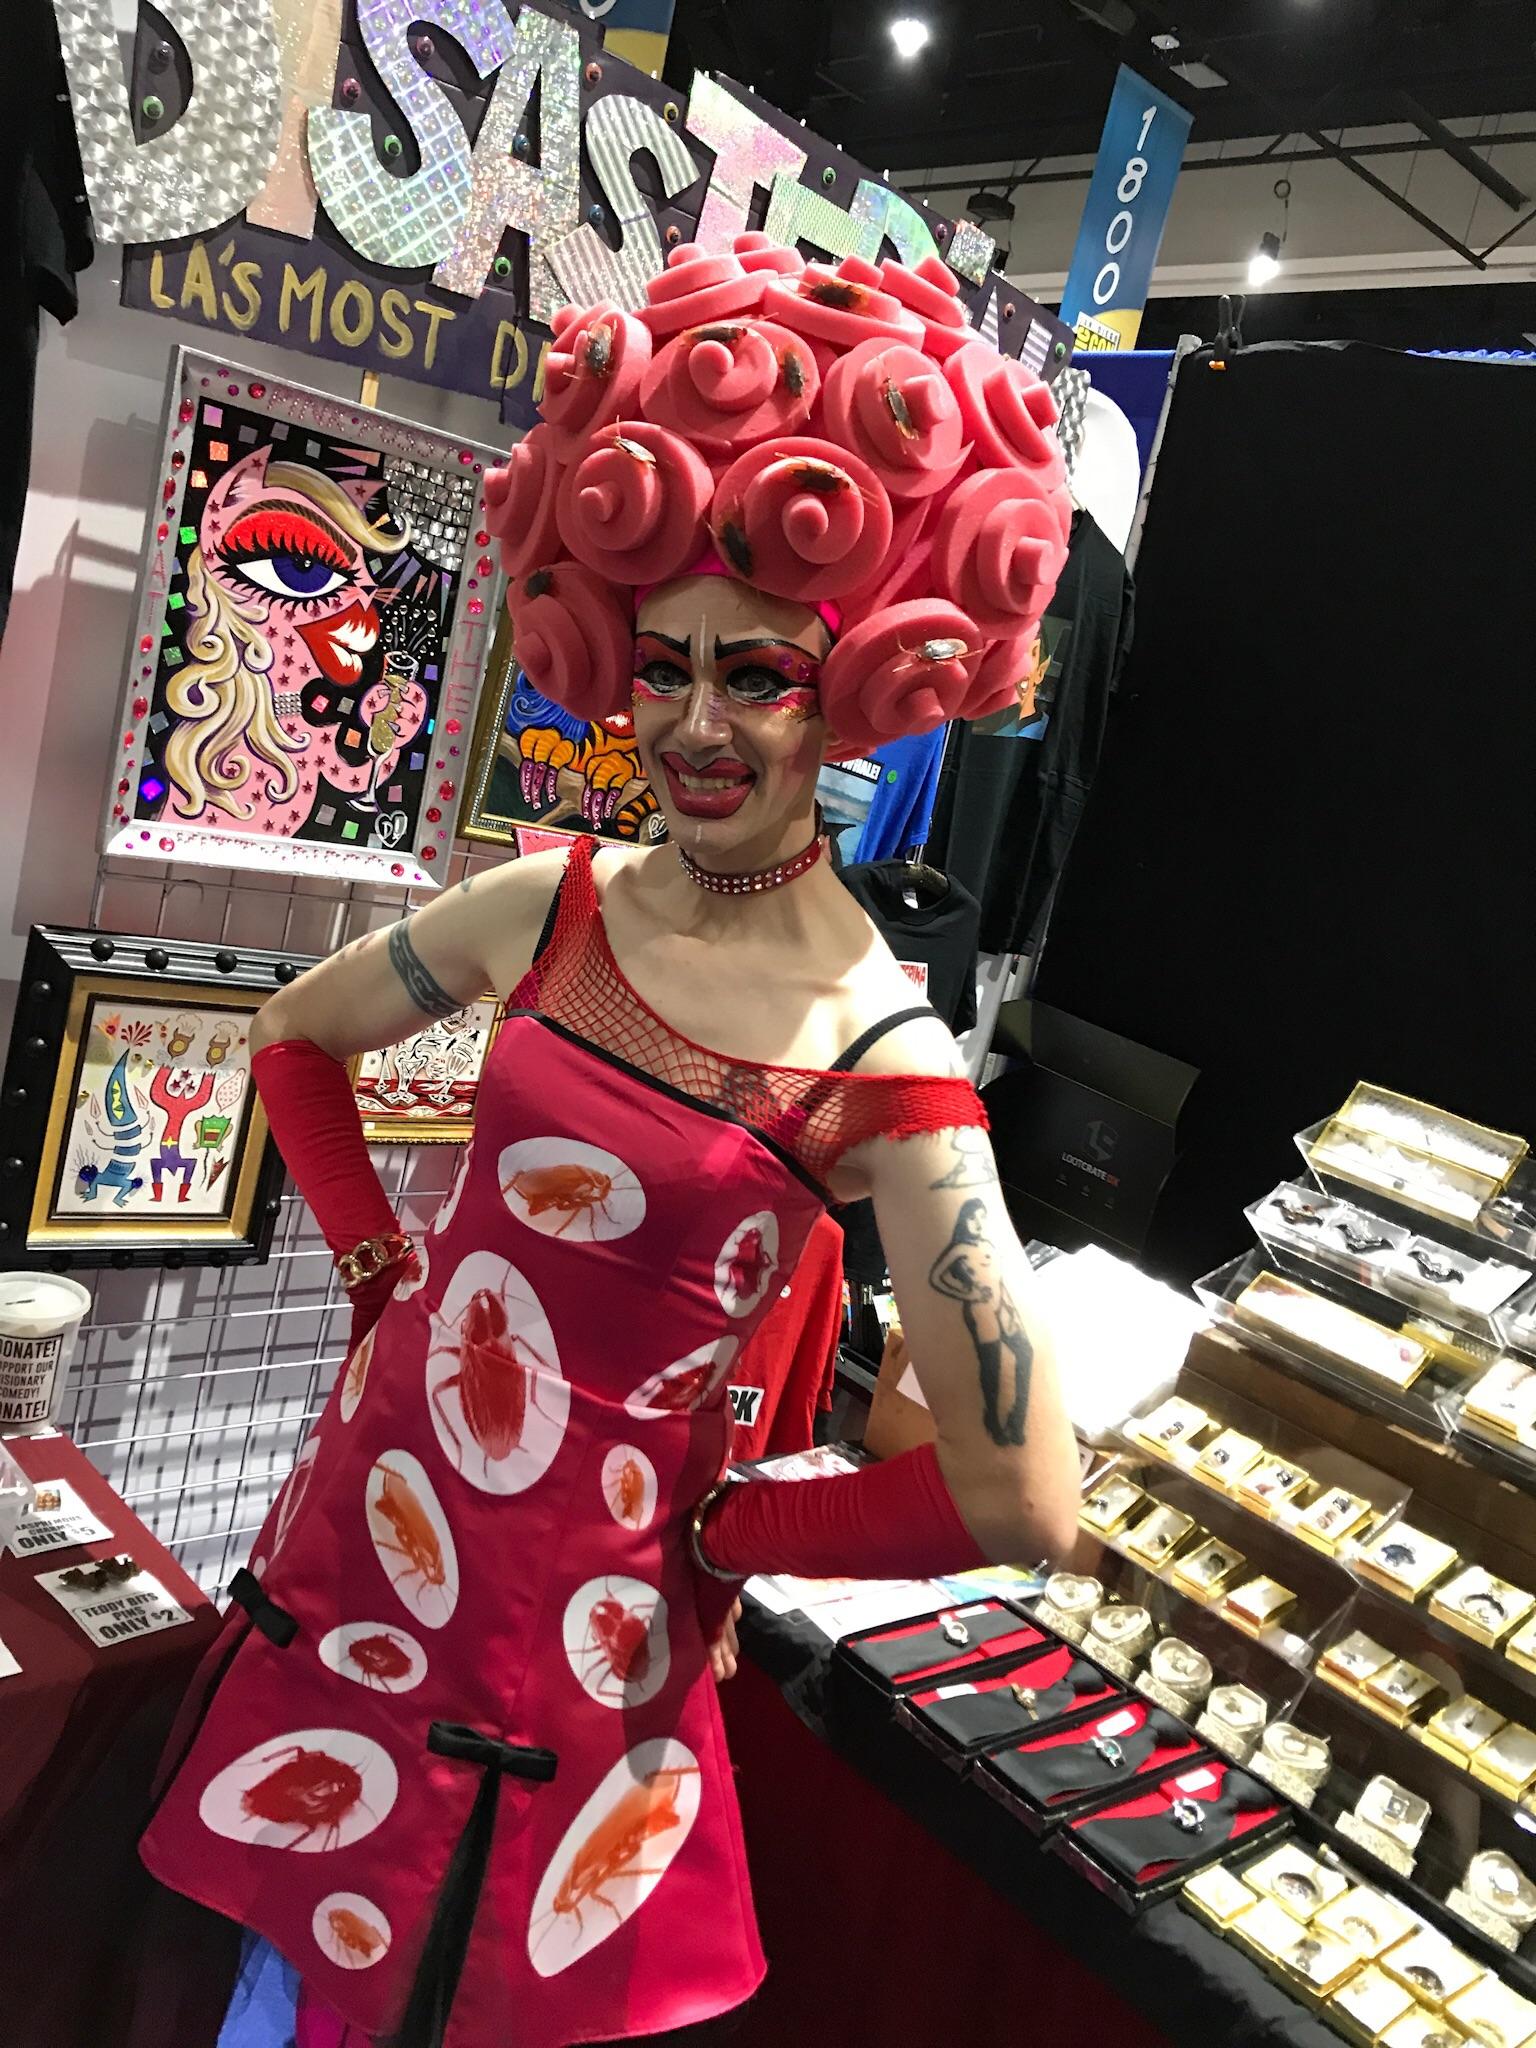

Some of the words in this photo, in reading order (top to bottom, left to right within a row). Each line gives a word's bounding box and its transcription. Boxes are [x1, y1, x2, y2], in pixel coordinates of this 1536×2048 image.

[1092, 105, 1157, 305] 1800
[151, 239, 263, 330] LA'S
[278, 262, 456, 369] MOST
[0, 1339, 57, 1359] ONATE!
[36, 1360, 54, 1373] OUR
[0, 1374, 46, 1386] SIONARY
[0, 1400, 46, 1419] NATE!
[18, 1531, 68, 1549] ONLY
[82, 1599, 125, 1617] TEDDY
[126, 1593, 158, 1606] BITS
[112, 1606, 145, 1621] PINS
[98, 1615, 152, 1639] ONLY
